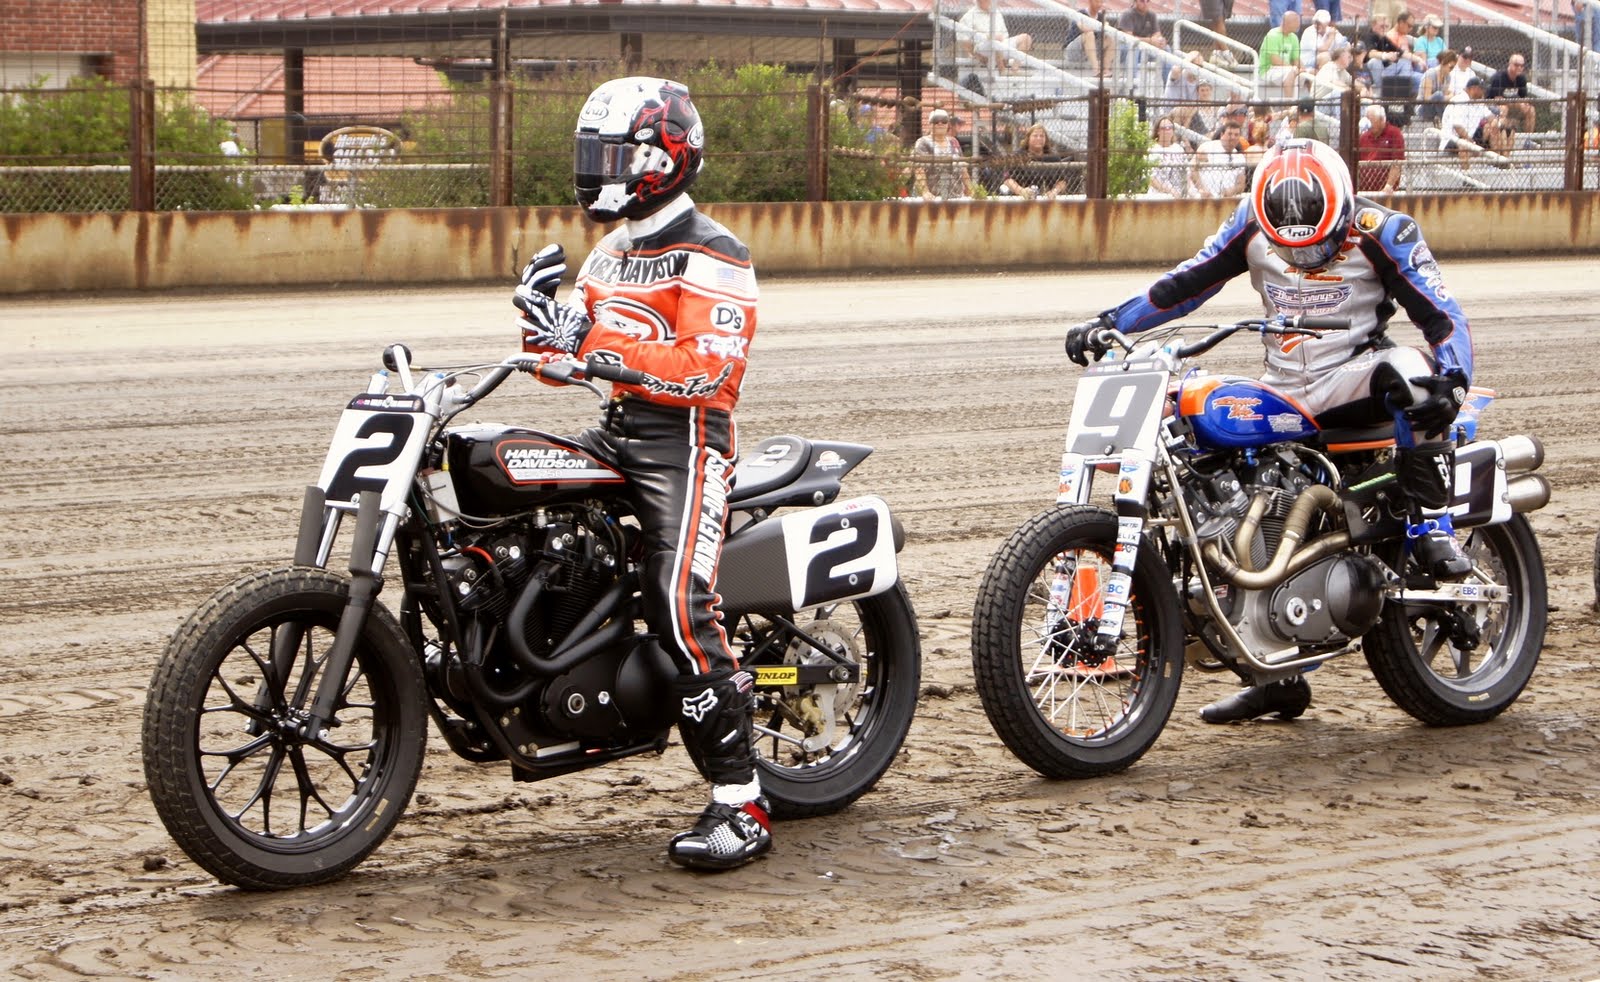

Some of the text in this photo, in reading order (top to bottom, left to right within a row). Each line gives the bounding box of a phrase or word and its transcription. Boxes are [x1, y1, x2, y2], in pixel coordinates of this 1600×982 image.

[1285, 228, 1312, 238] Arai
[716, 306, 742, 330] D's
[1070, 373, 1163, 455] 9
[325, 412, 415, 502] 2
[506, 459, 588, 469] DAVIDSON
[747, 444, 791, 468] 2
[800, 508, 879, 608] 2
[1462, 586, 1478, 596] EBC
[756, 671, 796, 681] UNLOP
